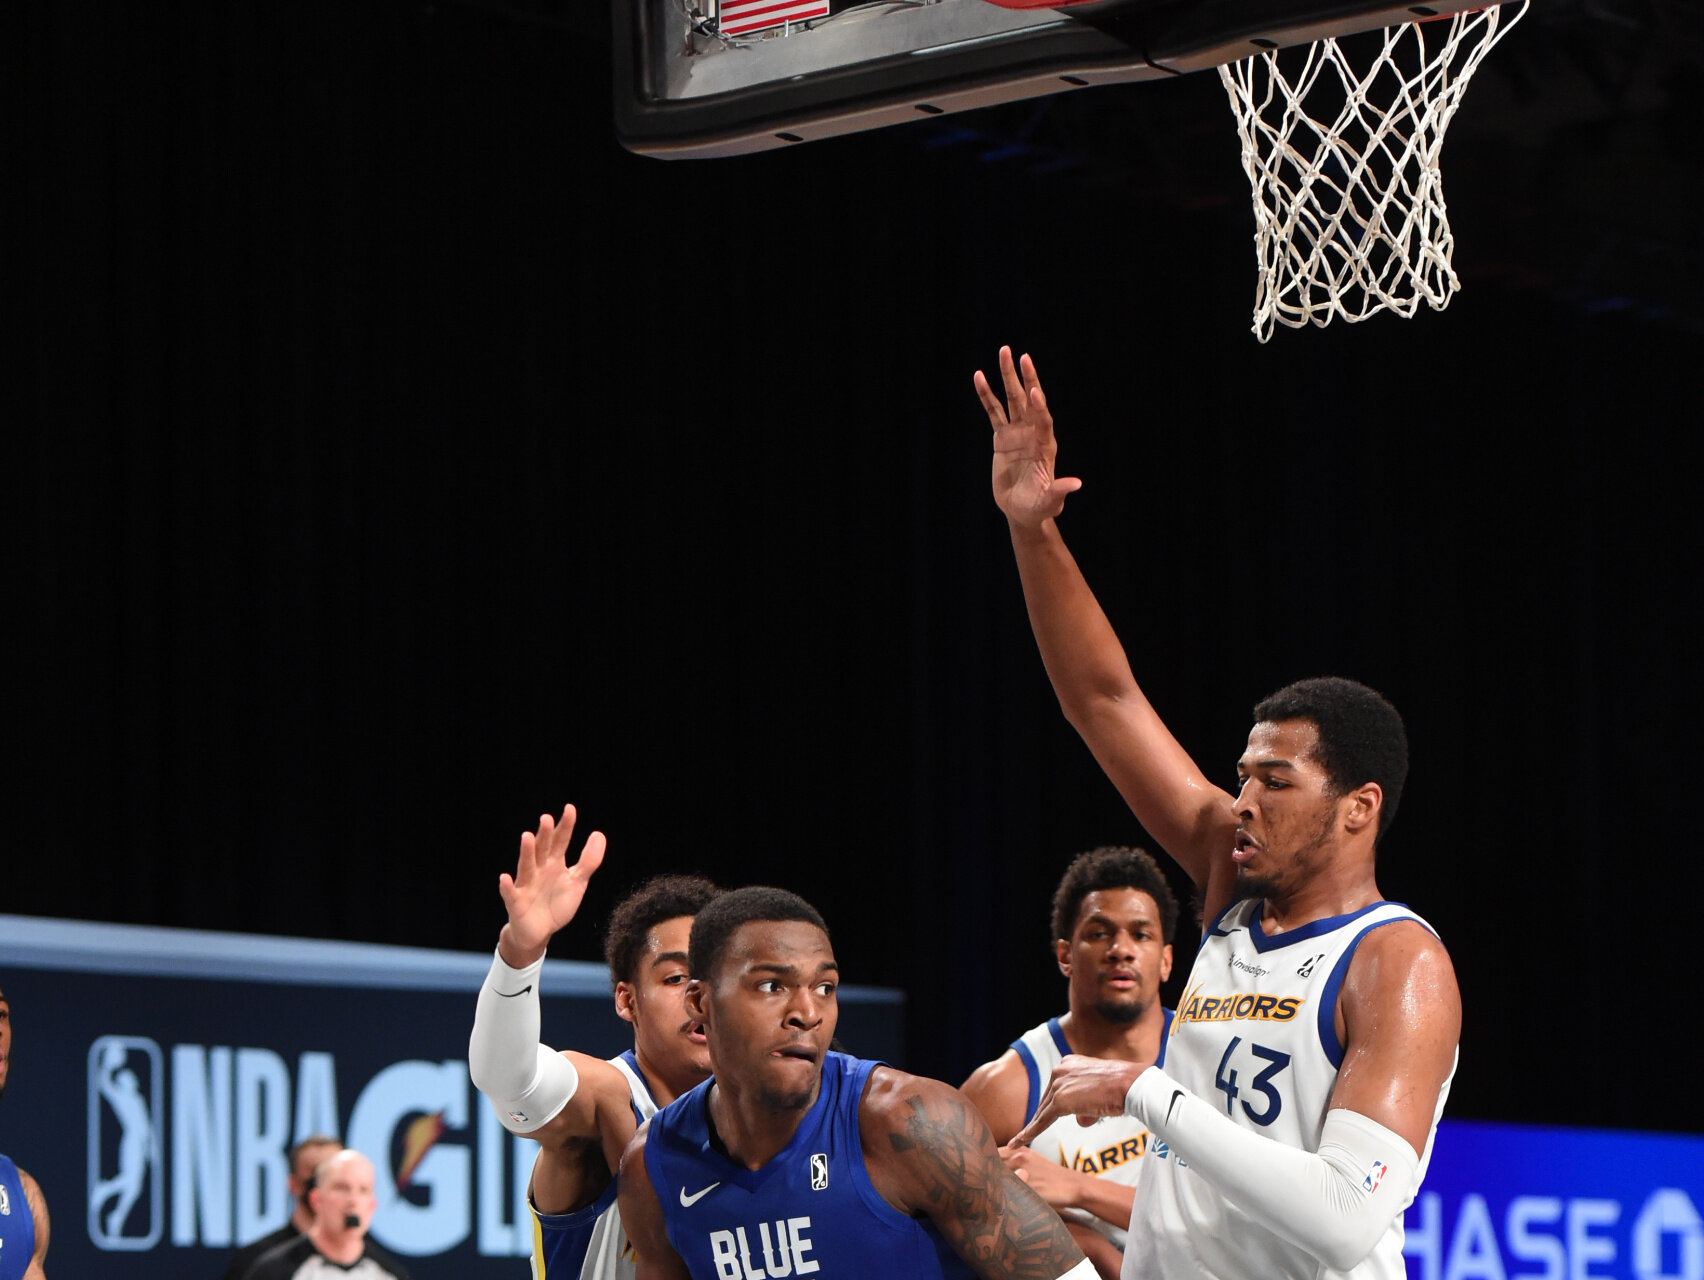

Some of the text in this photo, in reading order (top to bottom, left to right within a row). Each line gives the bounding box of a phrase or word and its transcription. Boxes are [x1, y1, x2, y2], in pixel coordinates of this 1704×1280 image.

[1169, 971, 1304, 1036] WARRIORS
[1215, 1036, 1291, 1127] 43
[1058, 1130, 1150, 1177] WARRI
